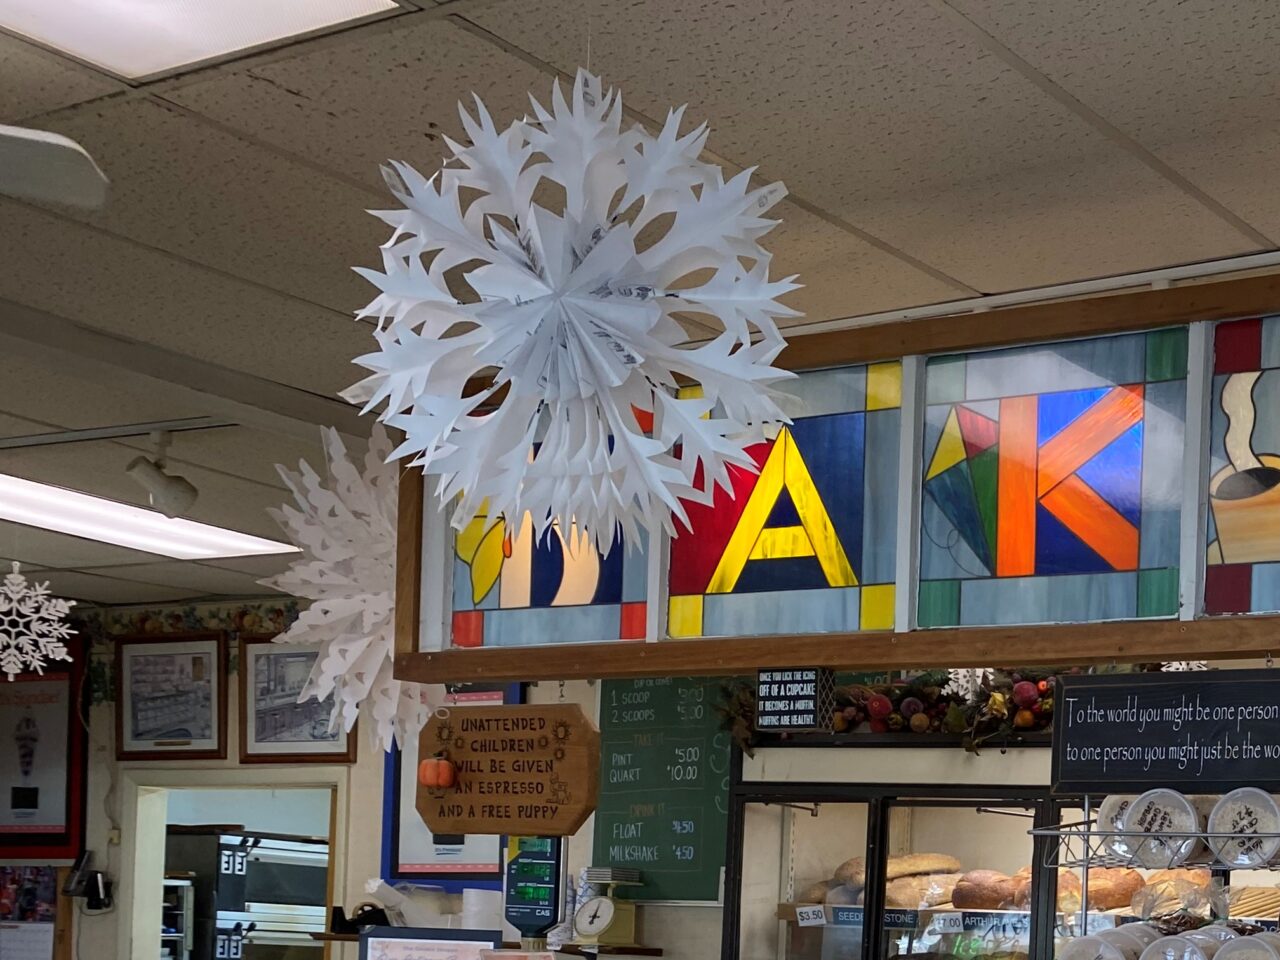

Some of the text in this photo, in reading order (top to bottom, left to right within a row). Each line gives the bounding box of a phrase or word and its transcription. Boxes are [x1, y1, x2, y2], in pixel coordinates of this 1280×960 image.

[759, 683, 816, 697] OFF OF A CUPCAKE
[622, 692, 650, 704] SCOOP
[759, 701, 764, 711] IT
[765, 700, 789, 711] BECOMES
[622, 709, 655, 722] SCOOPS
[1065, 698, 1085, 728] To
[1087, 696, 1104, 722] the
[1107, 695, 1138, 722] world
[1138, 708, 1160, 733] you
[1163, 694, 1193, 731] might
[1195, 693, 1210, 720] be
[1212, 706, 1235, 720] one
[1237, 705, 1278, 733] person
[461, 717, 546, 732] UNATTENDED
[470, 739, 535, 753] CHILDREN
[1066, 742, 1079, 761] to
[1080, 746, 1101, 761] one
[1103, 746, 1142, 773] person
[1144, 746, 1165, 771] you
[1168, 732, 1199, 769] might
[1196, 738, 1222, 776] just
[1224, 731, 1239, 759] be
[1242, 731, 1261, 759] the
[454, 759, 554, 774] WILL BE GIVEN
[612, 753, 632, 766] PINT
[609, 768, 641, 783] QUART
[455, 781, 544, 795] AN ESPRESSO
[438, 804, 558, 819] AND A FREE PUPPY
[613, 822, 644, 839] FLOAT
[609, 845, 660, 862] MILKSHAKE
[535, 909, 550, 917] CAS
[798, 909, 914, 924] $3.50 STONE
